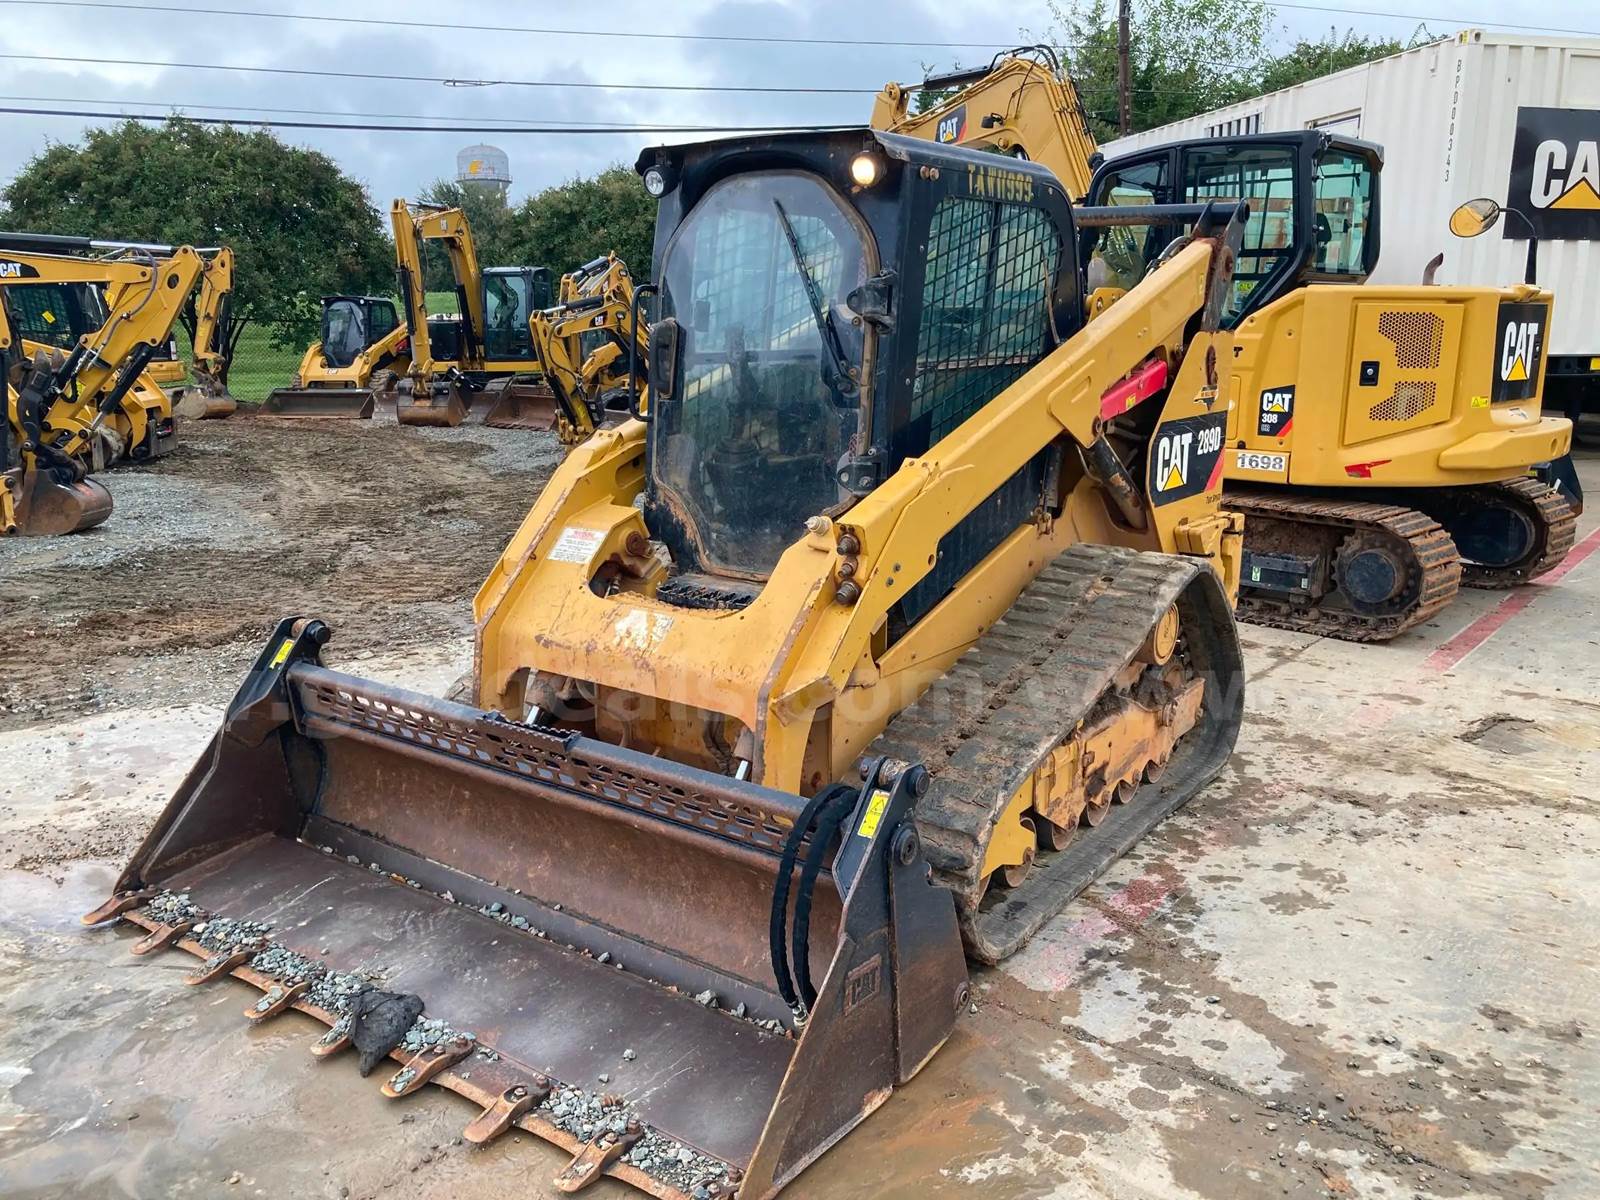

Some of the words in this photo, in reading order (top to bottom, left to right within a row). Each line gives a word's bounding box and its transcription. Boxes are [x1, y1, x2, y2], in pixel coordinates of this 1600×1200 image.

[940, 117, 958, 142] CAT
[0, 262, 22, 278] CAT
[1501, 321, 1539, 381] CAT
[1262, 392, 1292, 412] CAT
[1261, 413, 1278, 424] 308
[1156, 432, 1193, 492] CAT
[1197, 426, 1222, 455] 289D
[1237, 453, 1283, 470] 1698
